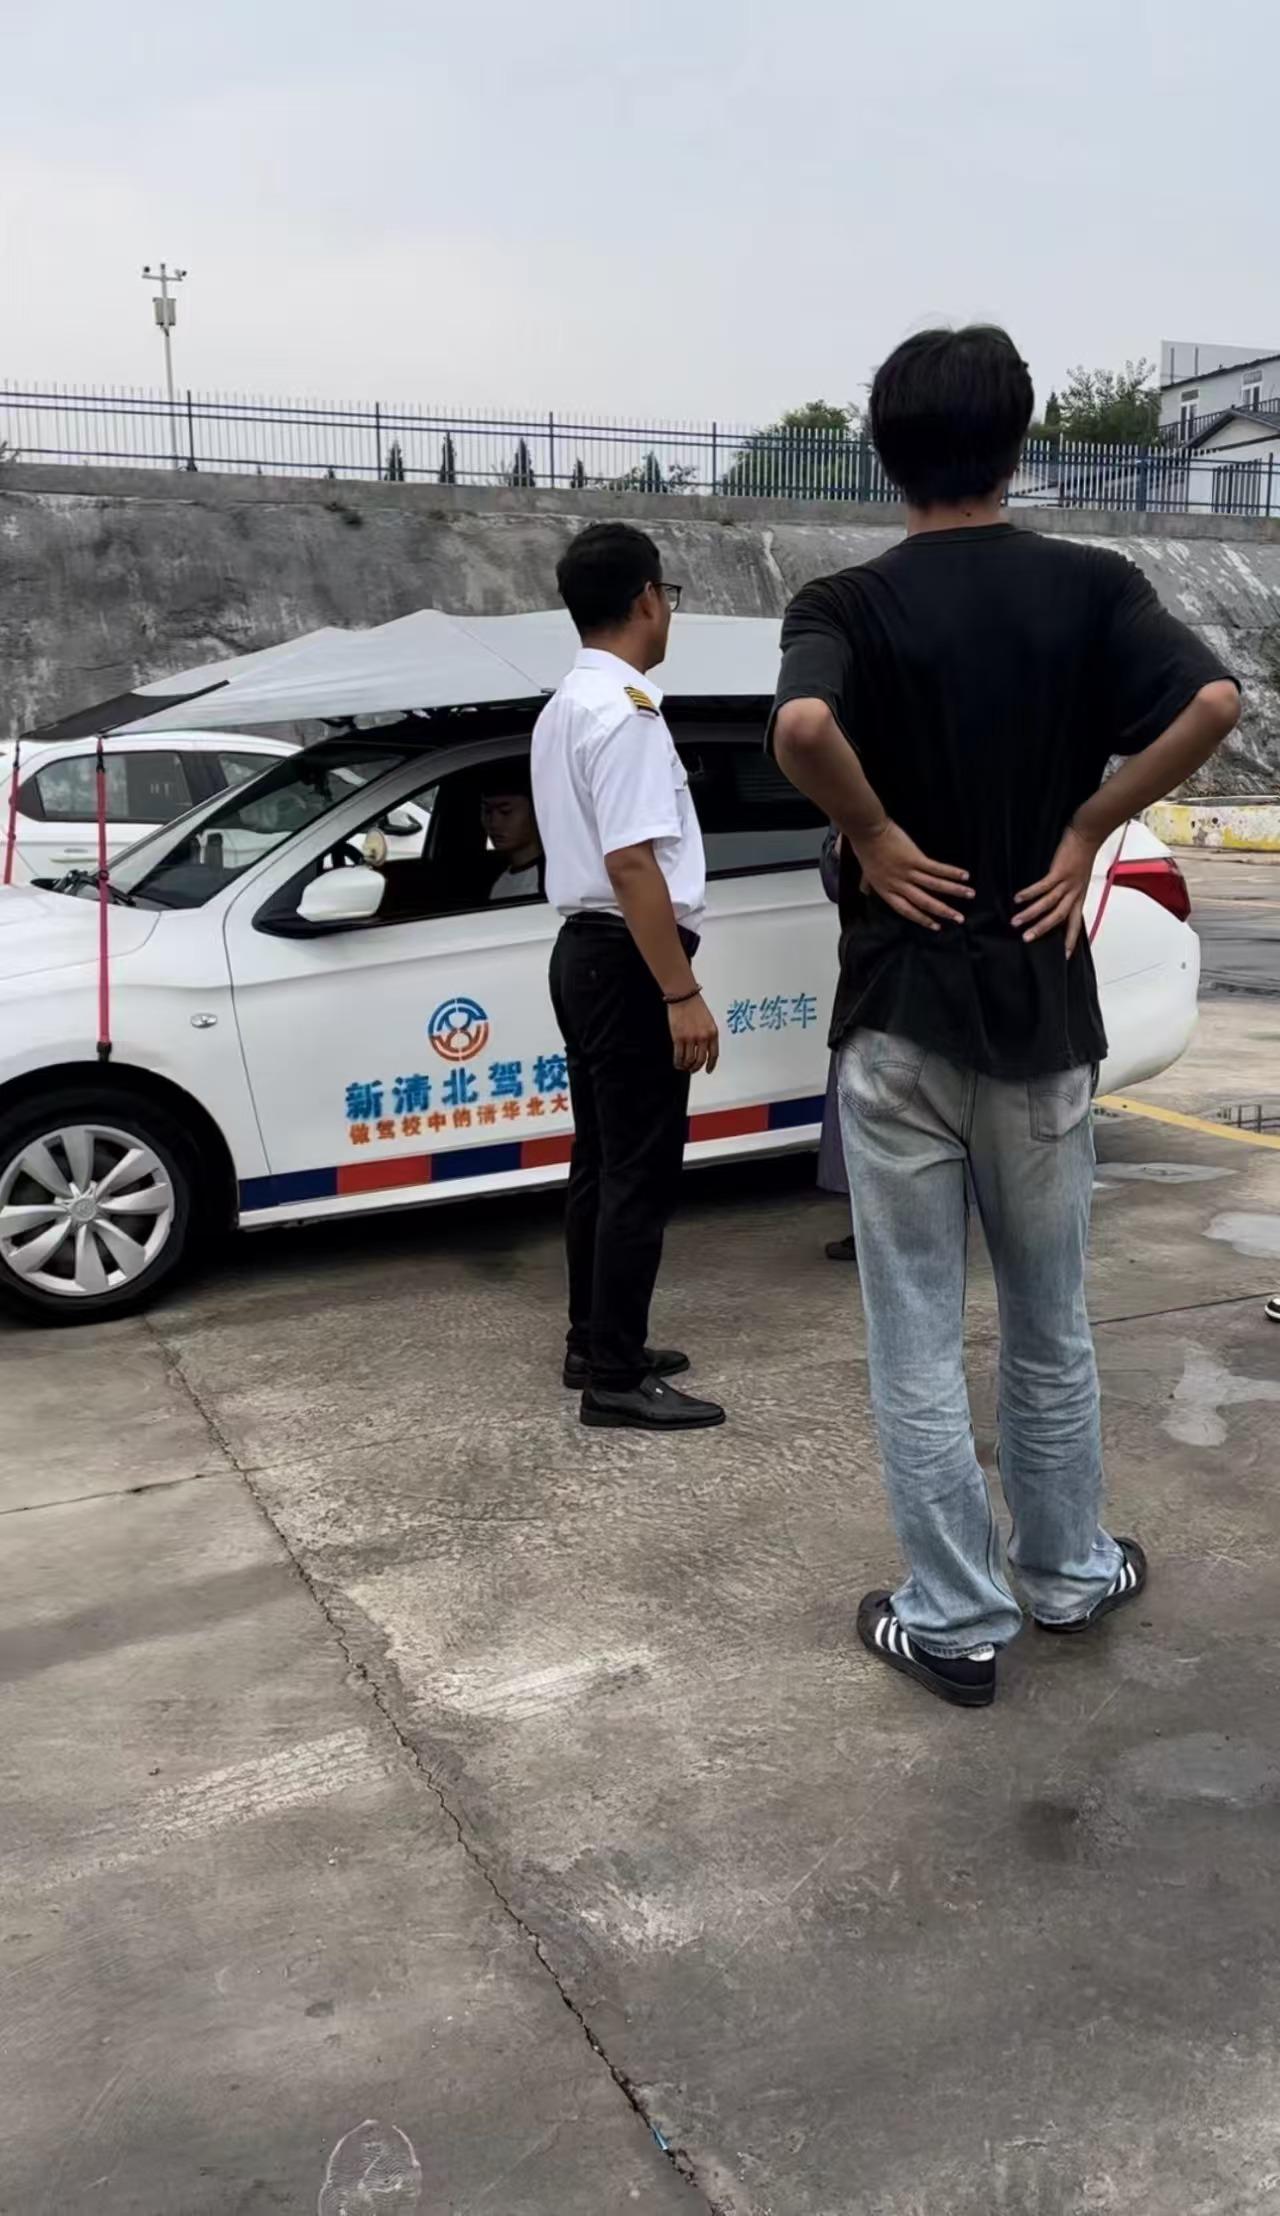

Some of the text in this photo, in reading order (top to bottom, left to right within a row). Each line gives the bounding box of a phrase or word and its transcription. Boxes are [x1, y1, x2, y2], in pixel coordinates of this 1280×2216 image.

[727, 992, 817, 1034] 教练车
[345, 1054, 568, 1119] 新清北驾校
[349, 1094, 568, 1145] 做驾校中的清华北大
